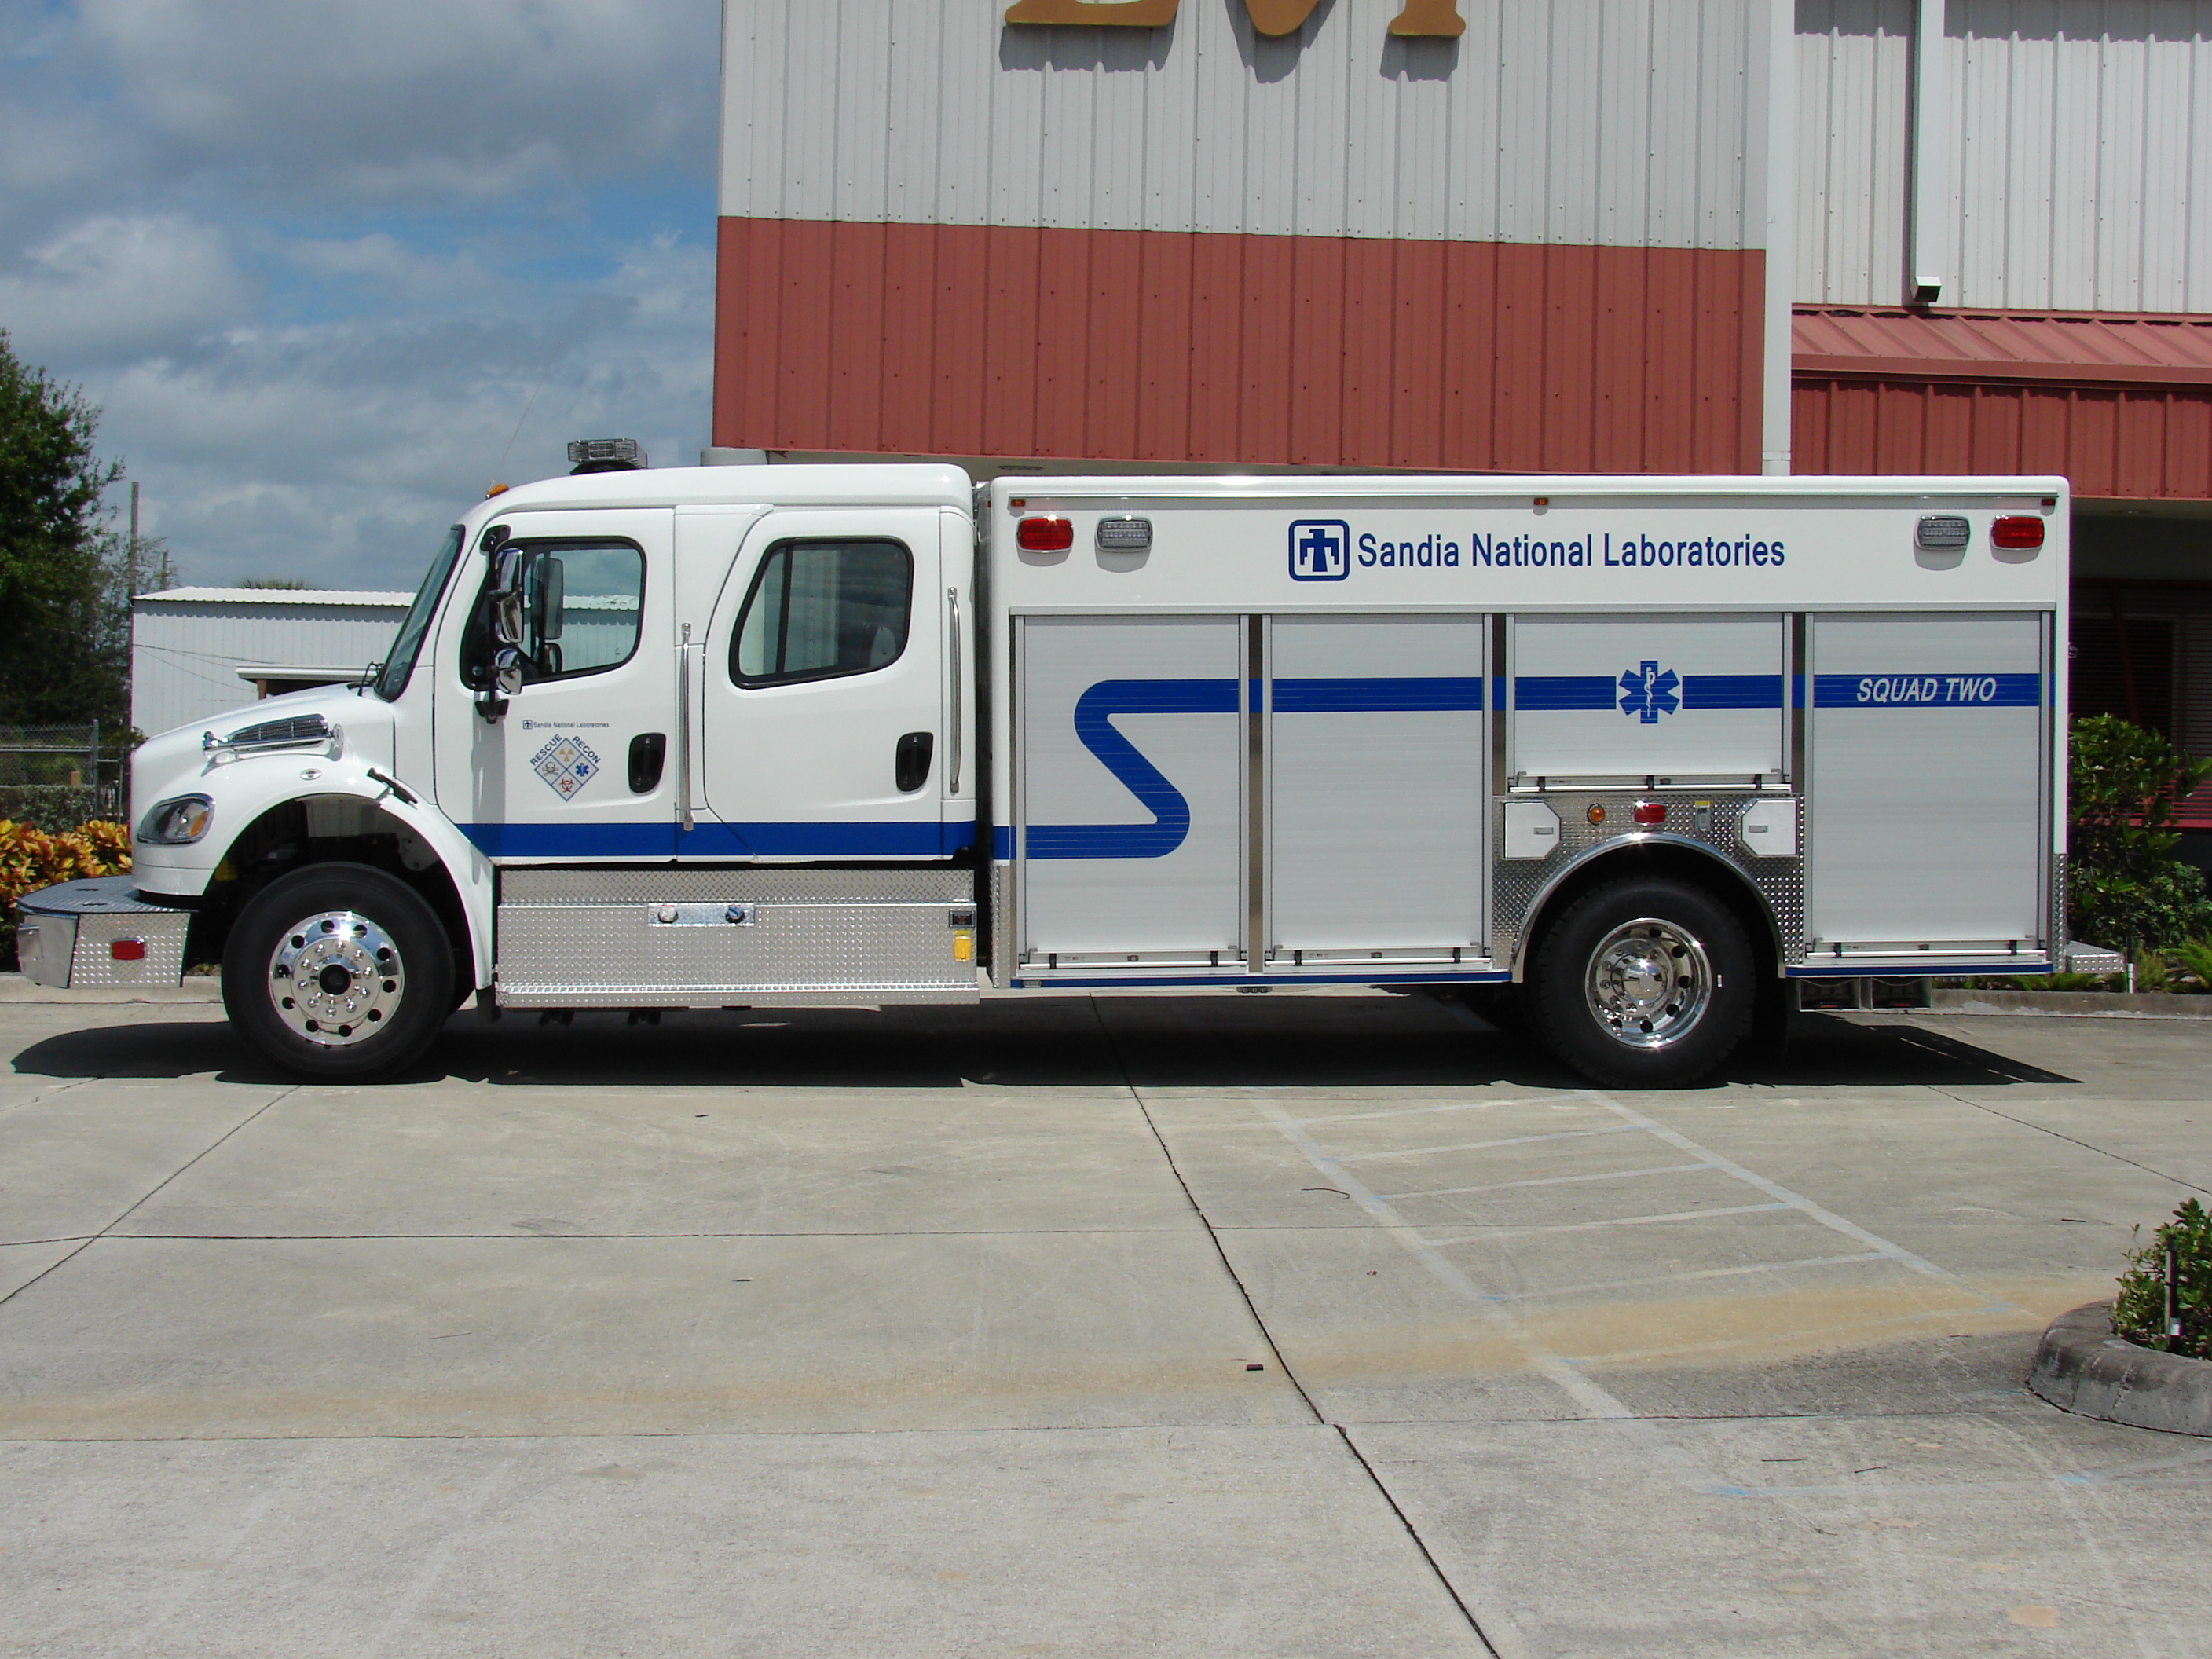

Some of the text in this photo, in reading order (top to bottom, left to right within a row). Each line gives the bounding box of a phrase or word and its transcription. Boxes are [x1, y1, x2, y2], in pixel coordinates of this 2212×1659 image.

[1357, 533, 1785, 568] Sandia National Laboratories
[1857, 677, 1997, 703] SQUAD TWO
[529, 734, 562, 766] RESCUE
[572, 735, 601, 764] RECON
